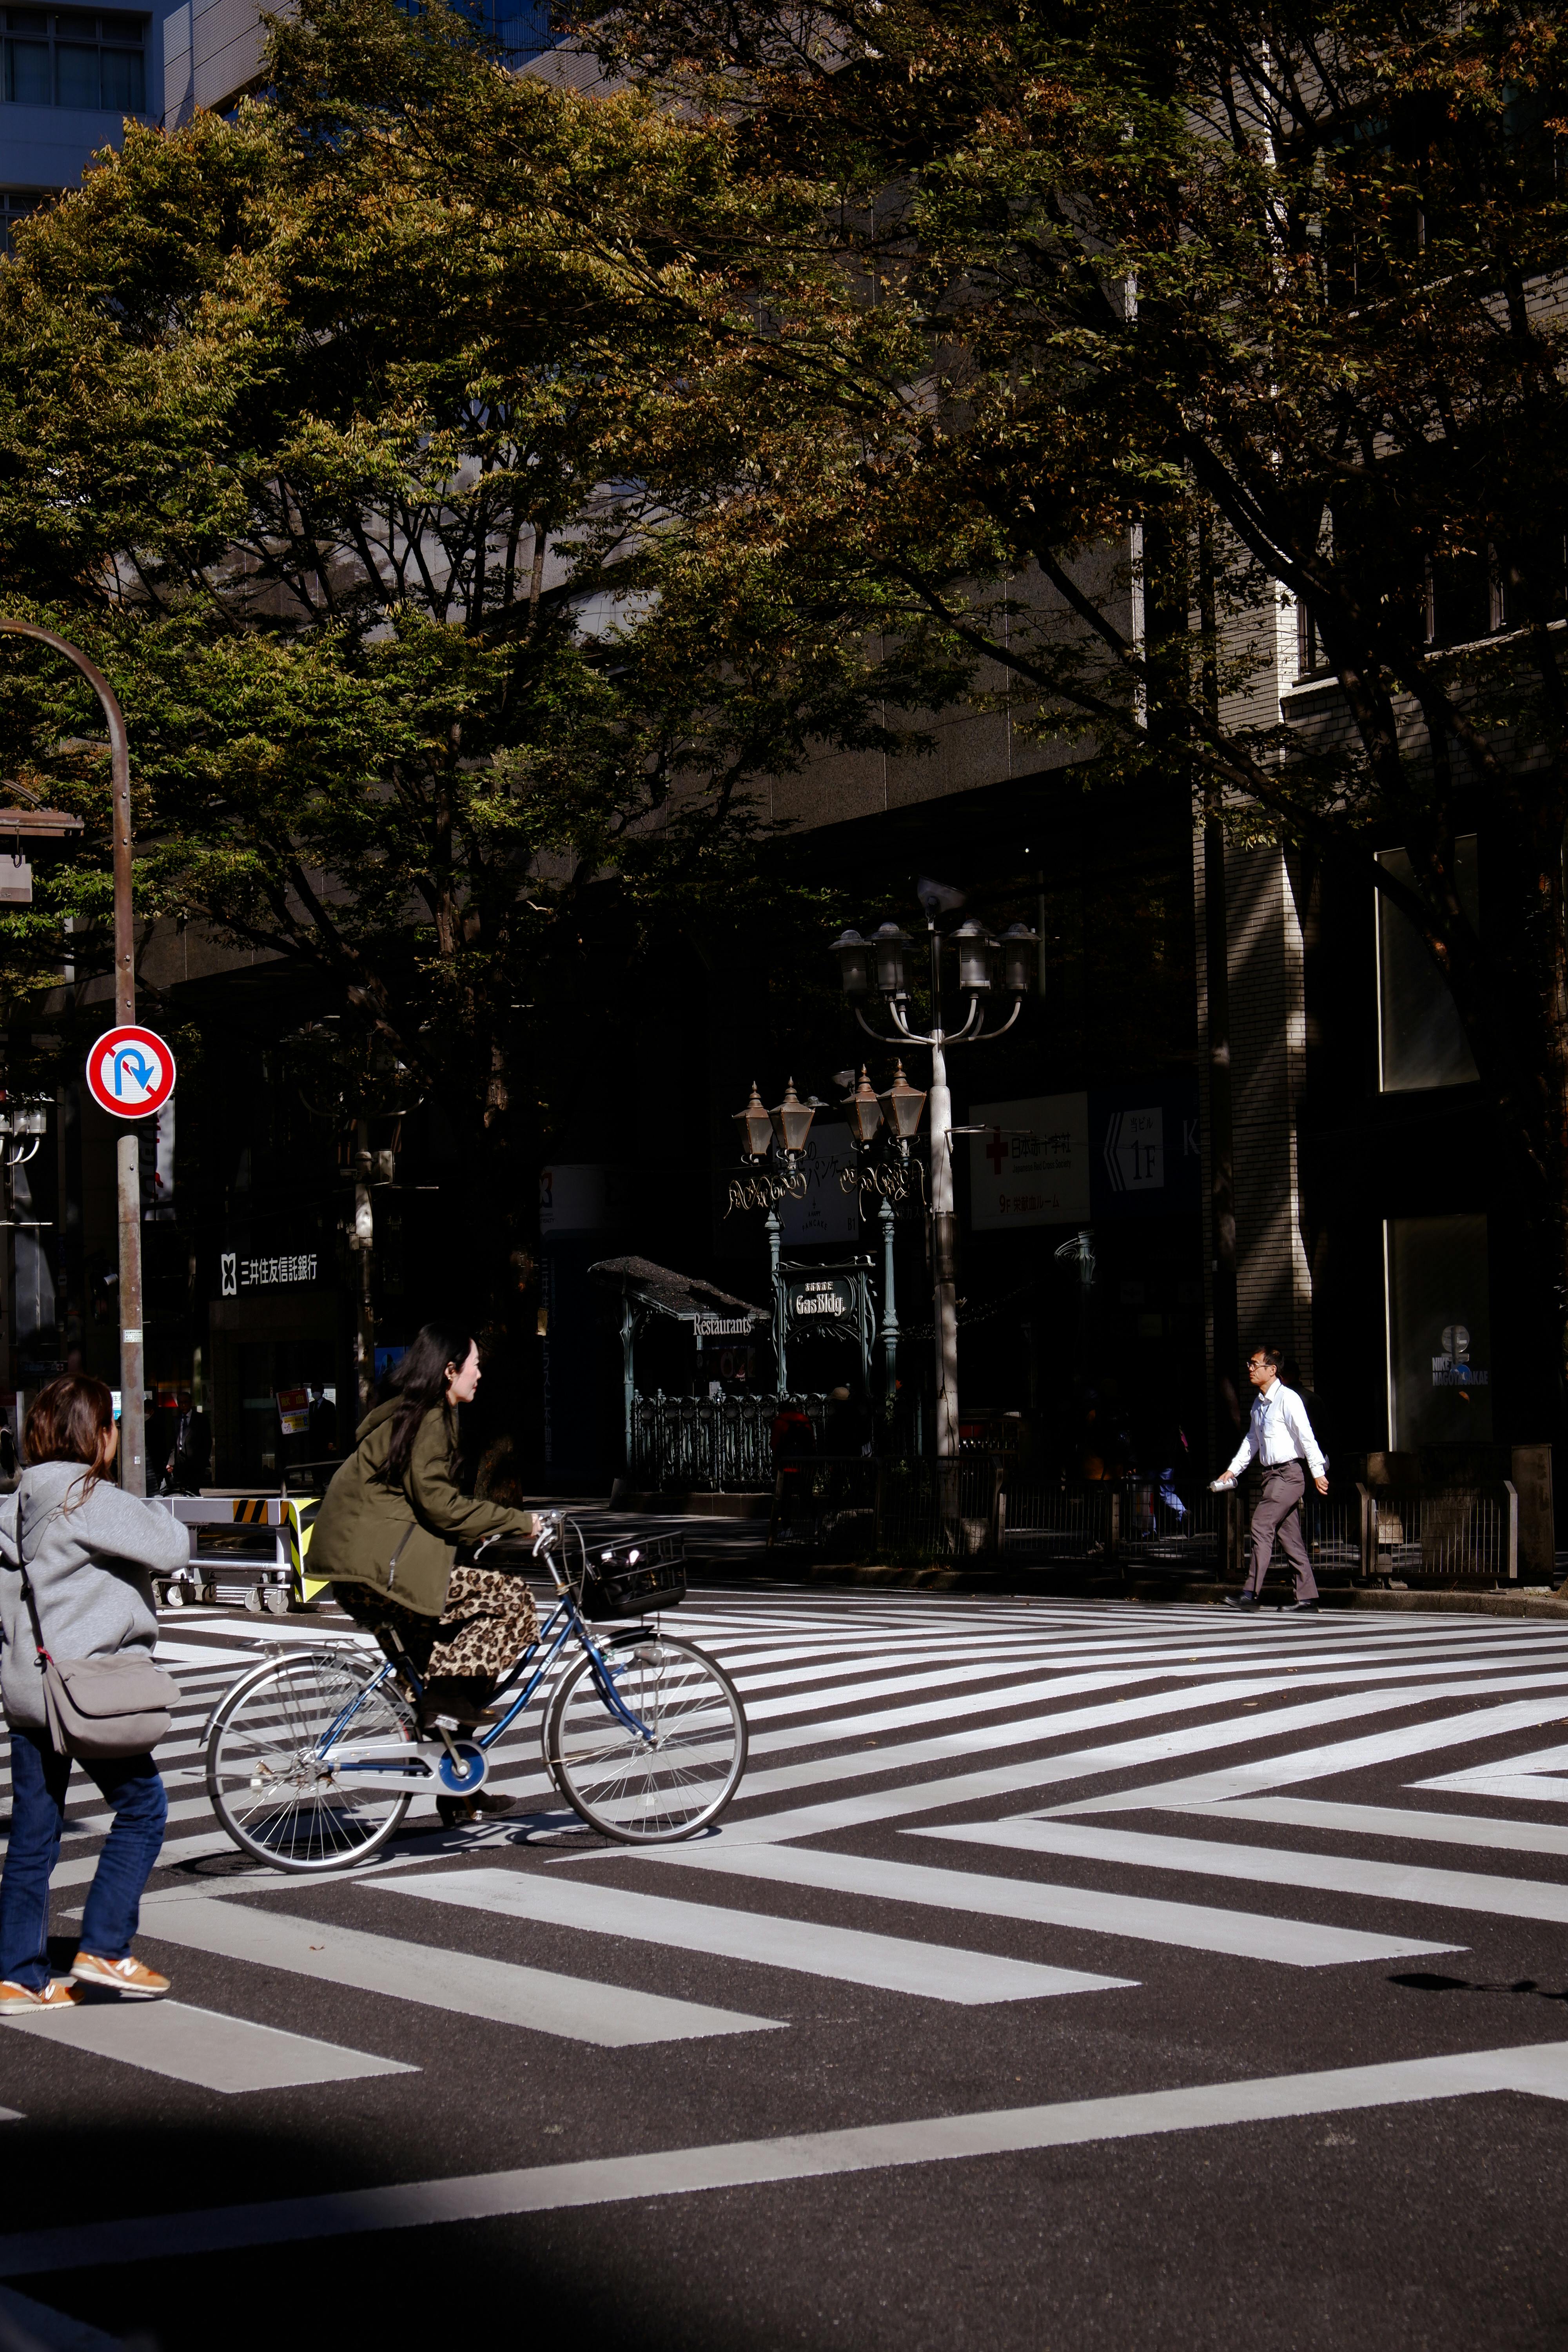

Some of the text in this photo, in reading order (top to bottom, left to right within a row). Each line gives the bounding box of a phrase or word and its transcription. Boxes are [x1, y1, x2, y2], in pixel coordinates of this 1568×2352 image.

[1012, 1132, 1071, 1159] 日本赤十字社
[1013, 1159, 1071, 1174] Japanese Red Cross Society
[1131, 1140, 1156, 1180] 1F
[999, 1194, 1060, 1213] 9F 栄献血ルーム
[802, 1219, 828, 1232] PANCAKE
[848, 1218, 855, 1231] B1
[241, 1254, 317, 1285] 三井住友信託銀行
[693, 1313, 751, 1336] Restaurants
[1432, 1357, 1450, 1372] NIKE
